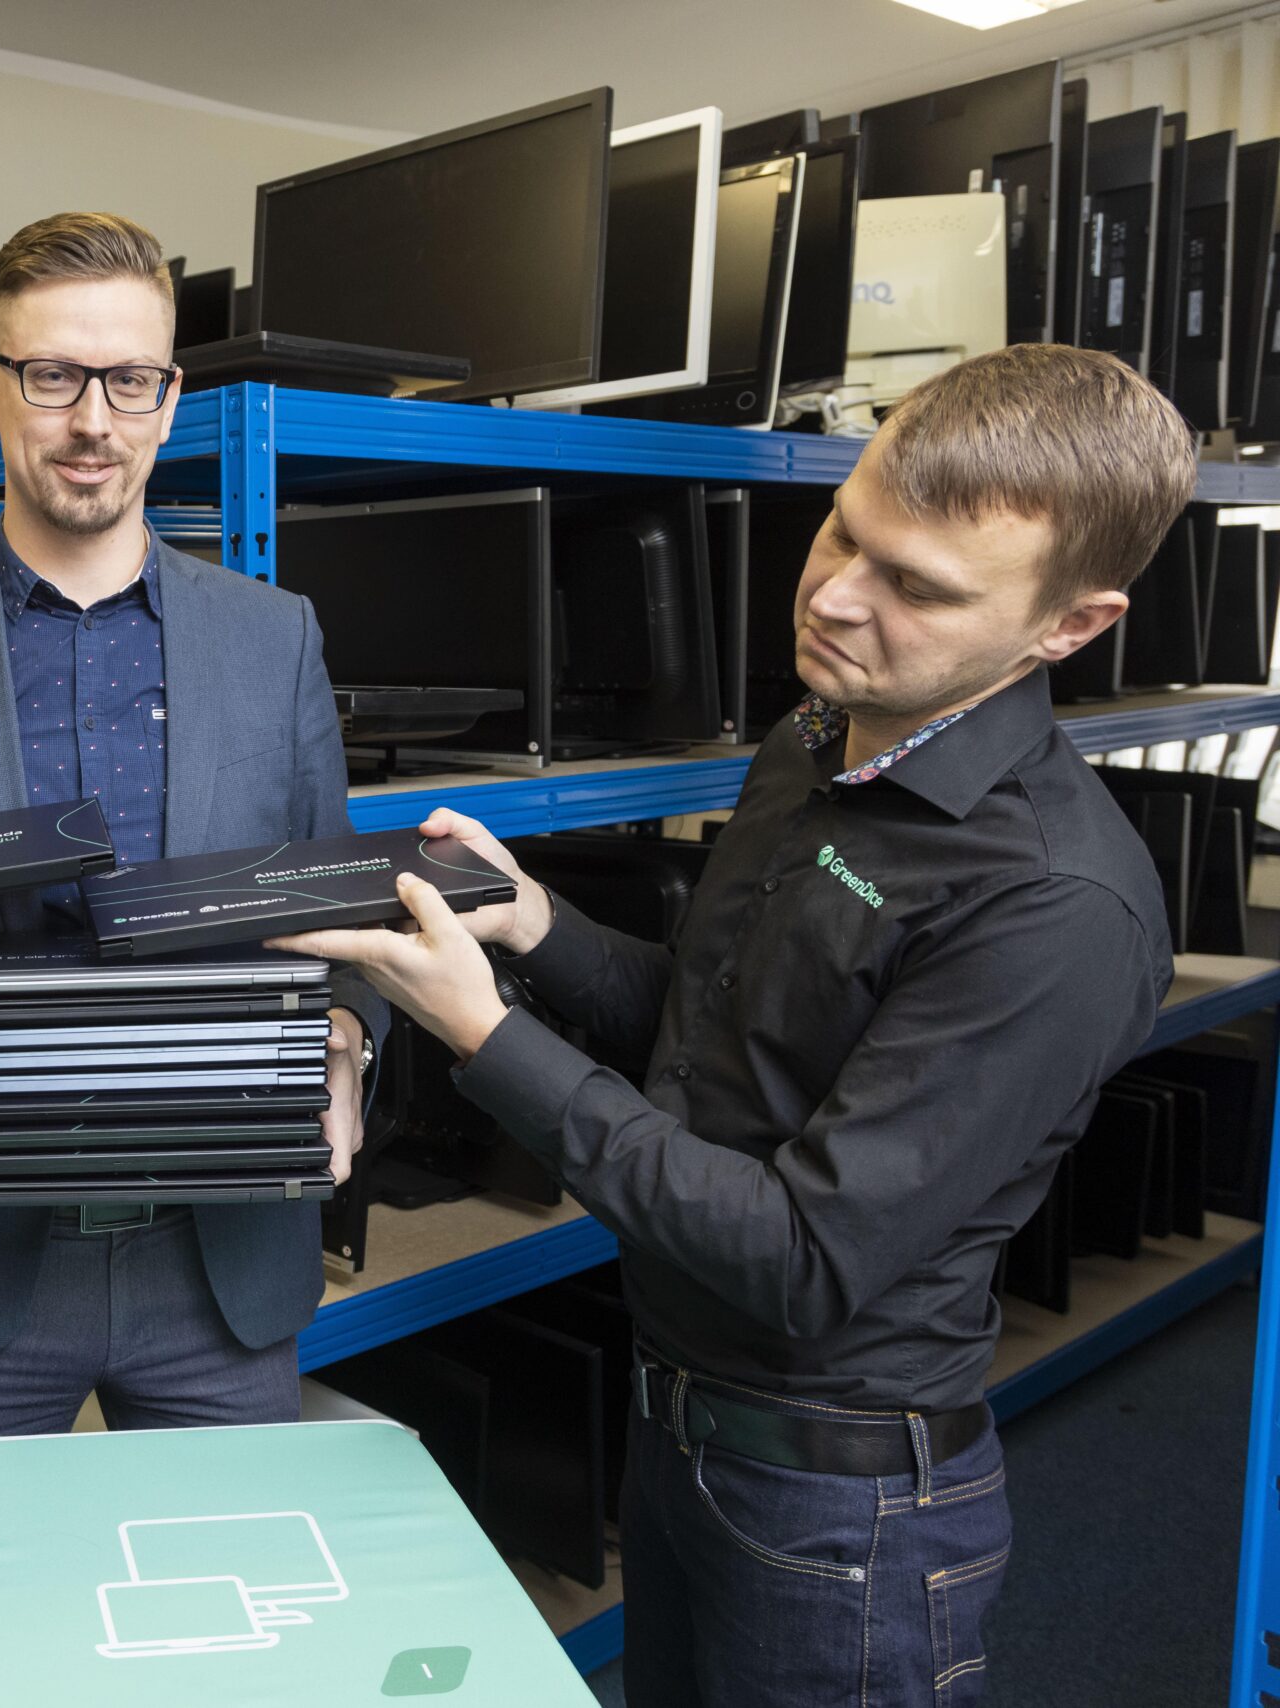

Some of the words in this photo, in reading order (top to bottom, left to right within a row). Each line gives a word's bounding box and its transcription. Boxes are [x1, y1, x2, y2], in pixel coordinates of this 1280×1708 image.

[852, 281, 896, 305] nQ
[829, 857, 884, 909] GreenDice
[128, 910, 191, 922] GreenDice
